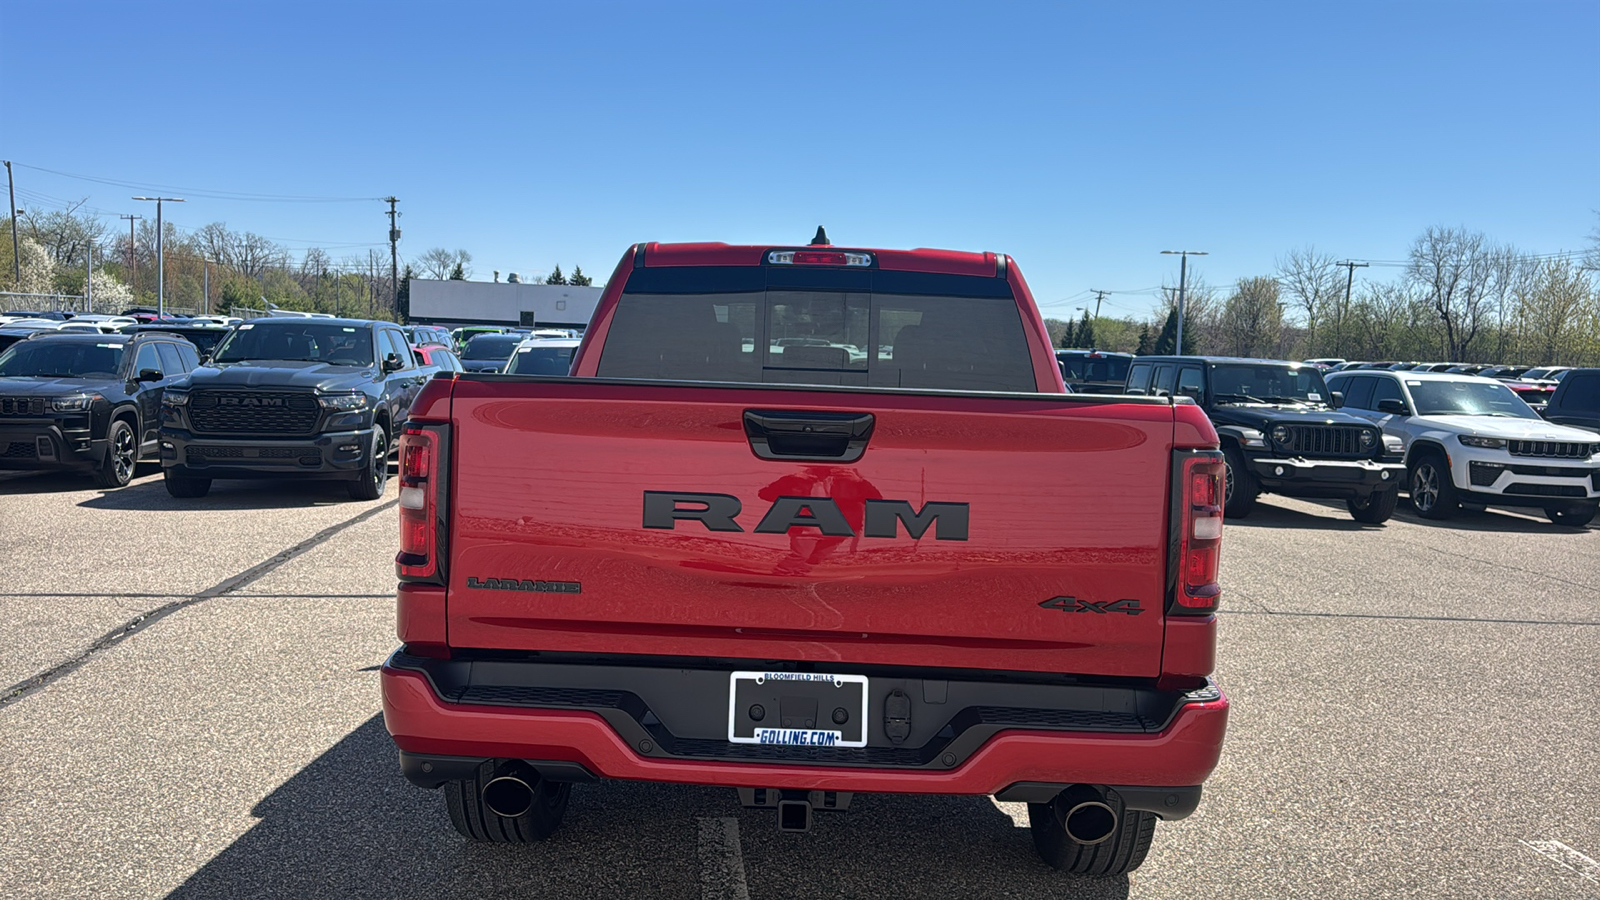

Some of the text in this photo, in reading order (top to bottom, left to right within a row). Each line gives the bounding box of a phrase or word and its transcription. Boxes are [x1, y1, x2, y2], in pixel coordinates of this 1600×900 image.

[221, 397, 283, 406] RAM
[643, 490, 969, 541] RAM
[467, 576, 581, 594] LARAMIE
[764, 673, 835, 682] BLOOMFIELD HILLS
[760, 729, 836, 746] GOLLING.COM
